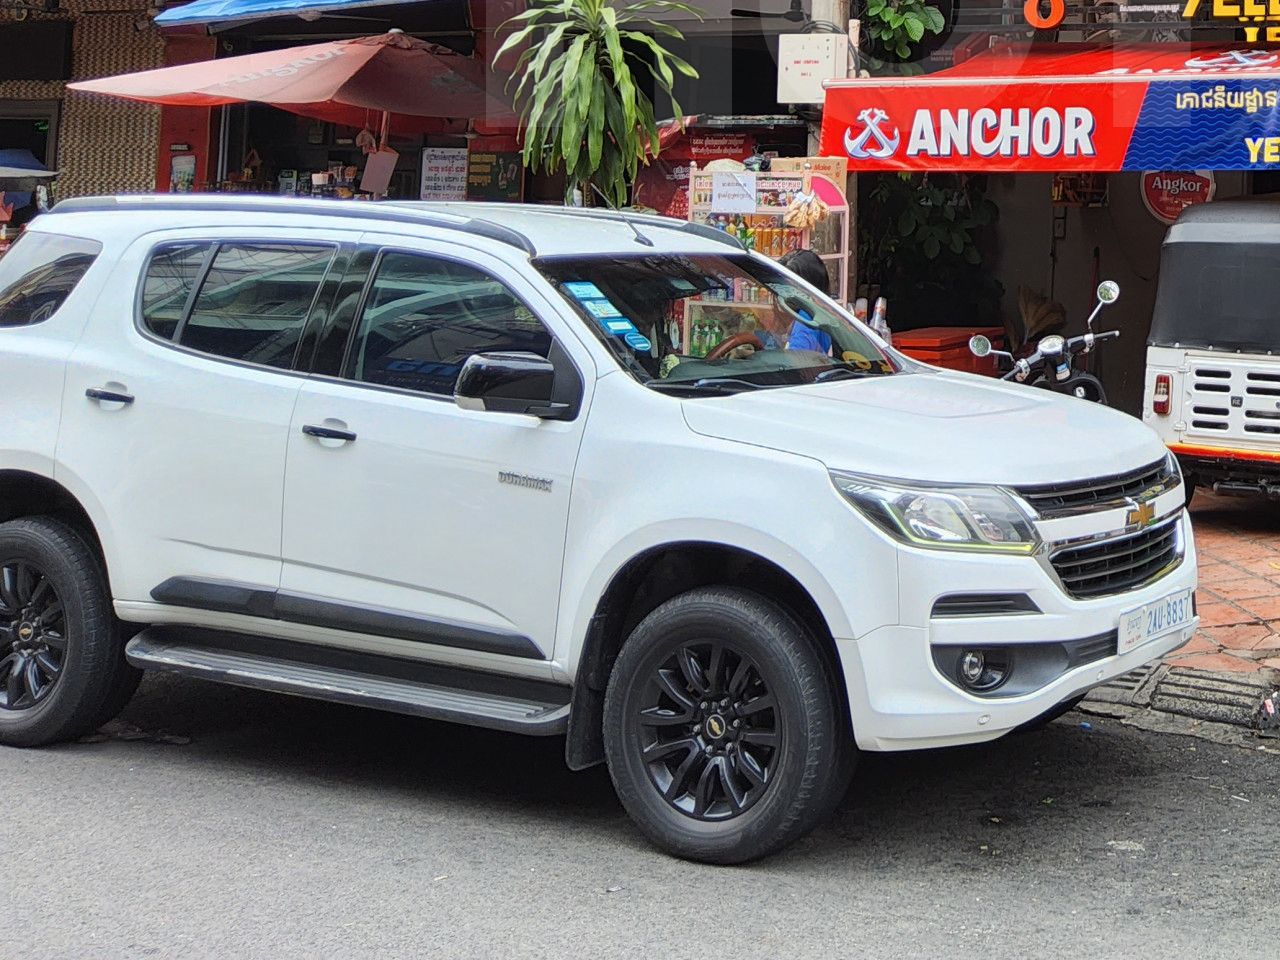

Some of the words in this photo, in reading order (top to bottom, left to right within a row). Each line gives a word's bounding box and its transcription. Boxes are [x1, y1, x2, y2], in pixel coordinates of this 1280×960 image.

[907, 107, 1098, 158] ANCHOR
[1151, 177, 1203, 195] Angkor
[498, 471, 554, 493] DURAMAX
[1146, 594, 1190, 634] 2AU-8837
